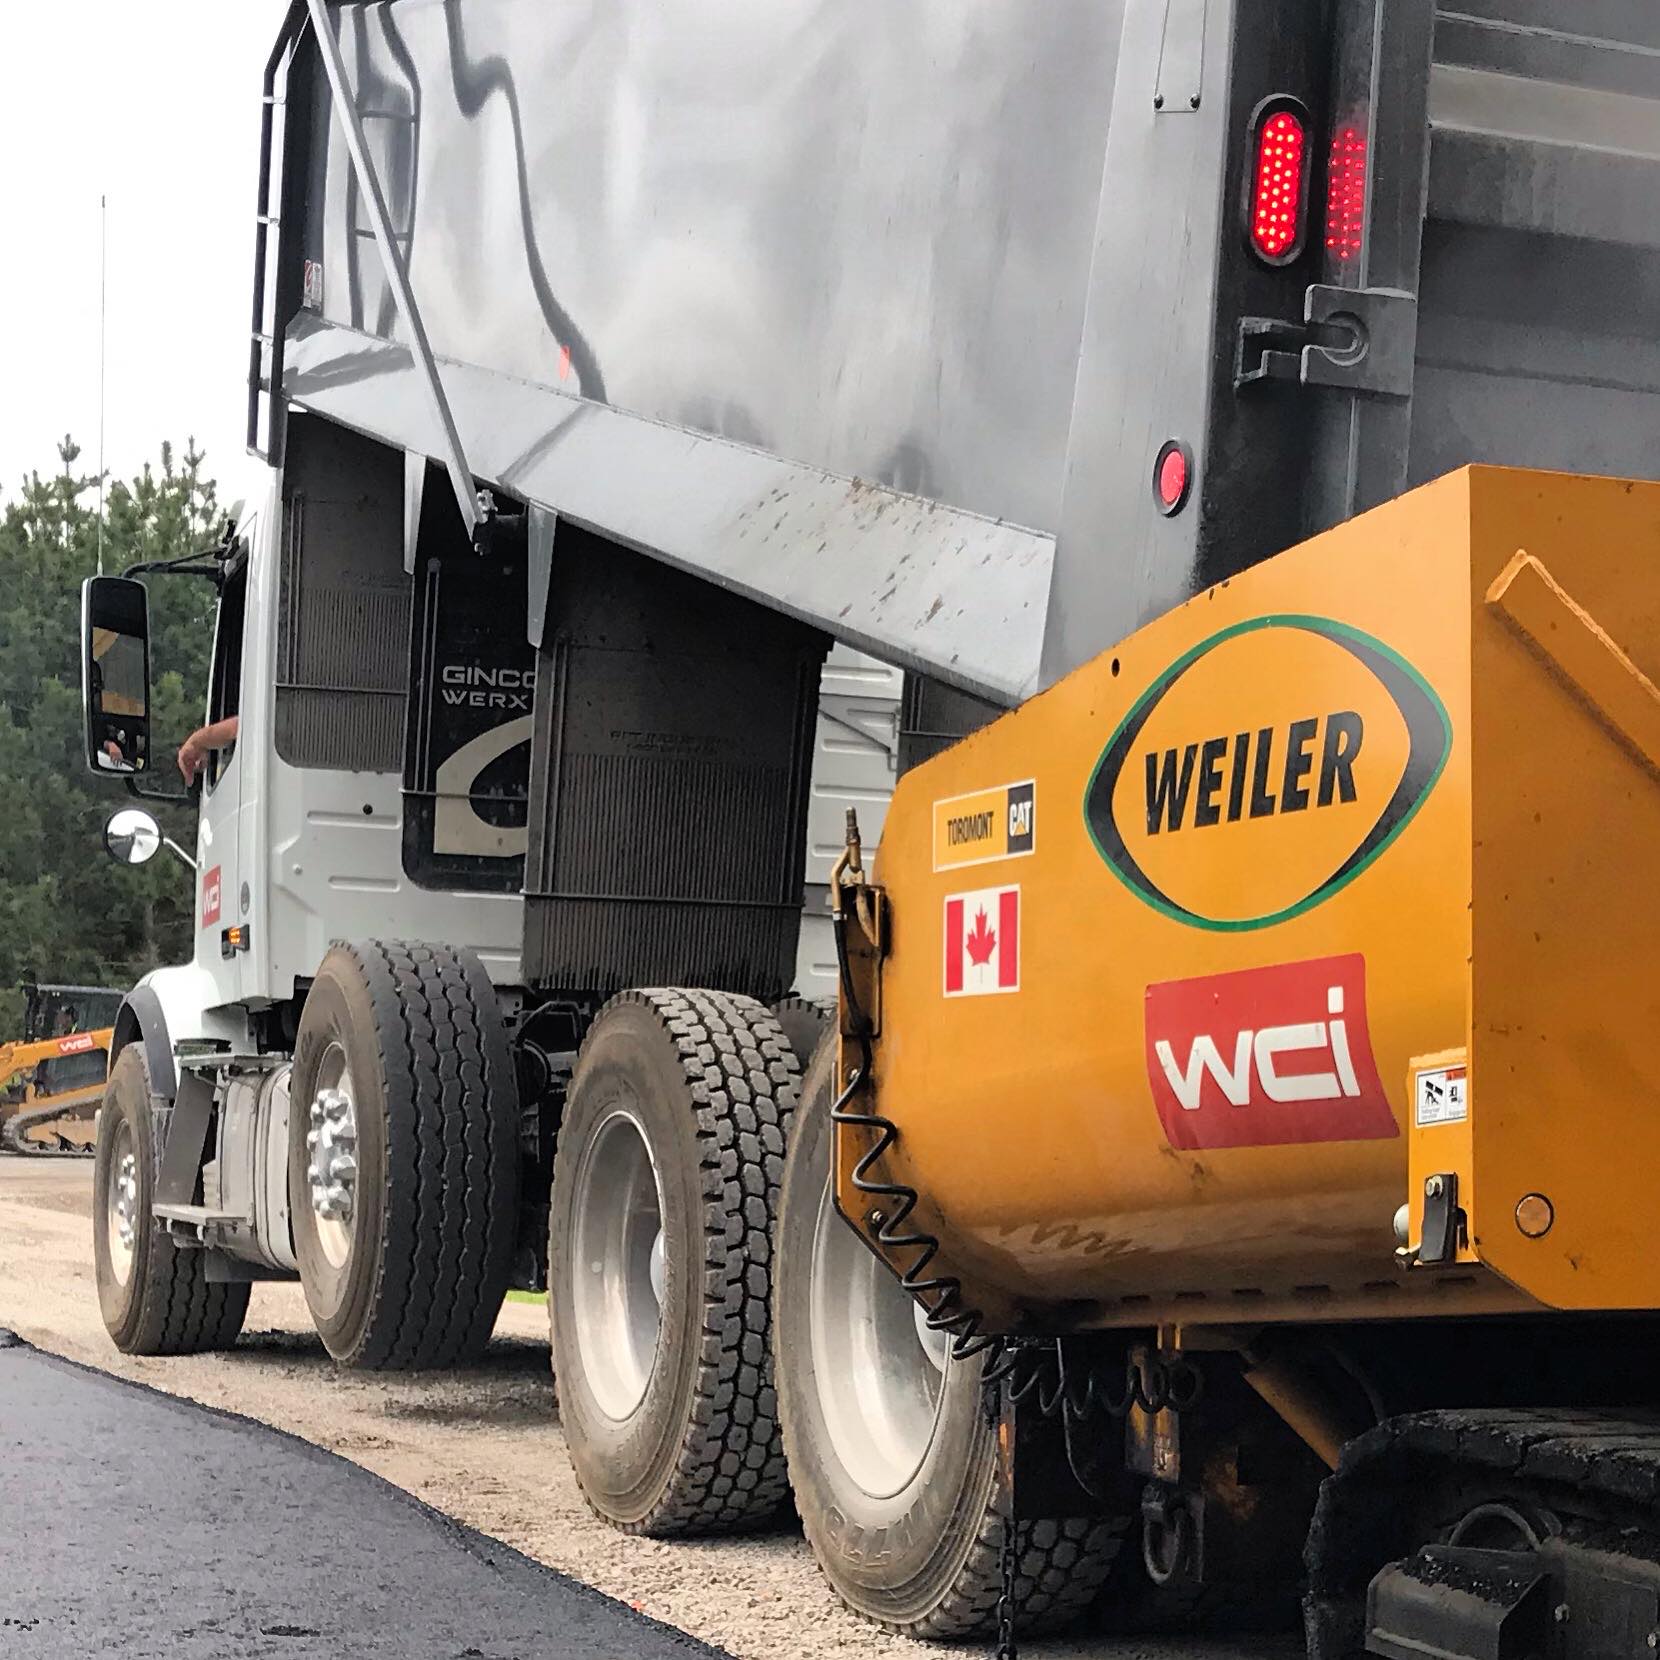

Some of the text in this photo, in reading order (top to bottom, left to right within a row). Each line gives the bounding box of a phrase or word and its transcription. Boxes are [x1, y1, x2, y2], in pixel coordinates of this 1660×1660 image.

[441, 689, 529, 710] WERX
[1145, 710, 1364, 837] WEILER
[947, 801, 1032, 847] TOROMONT CAT
